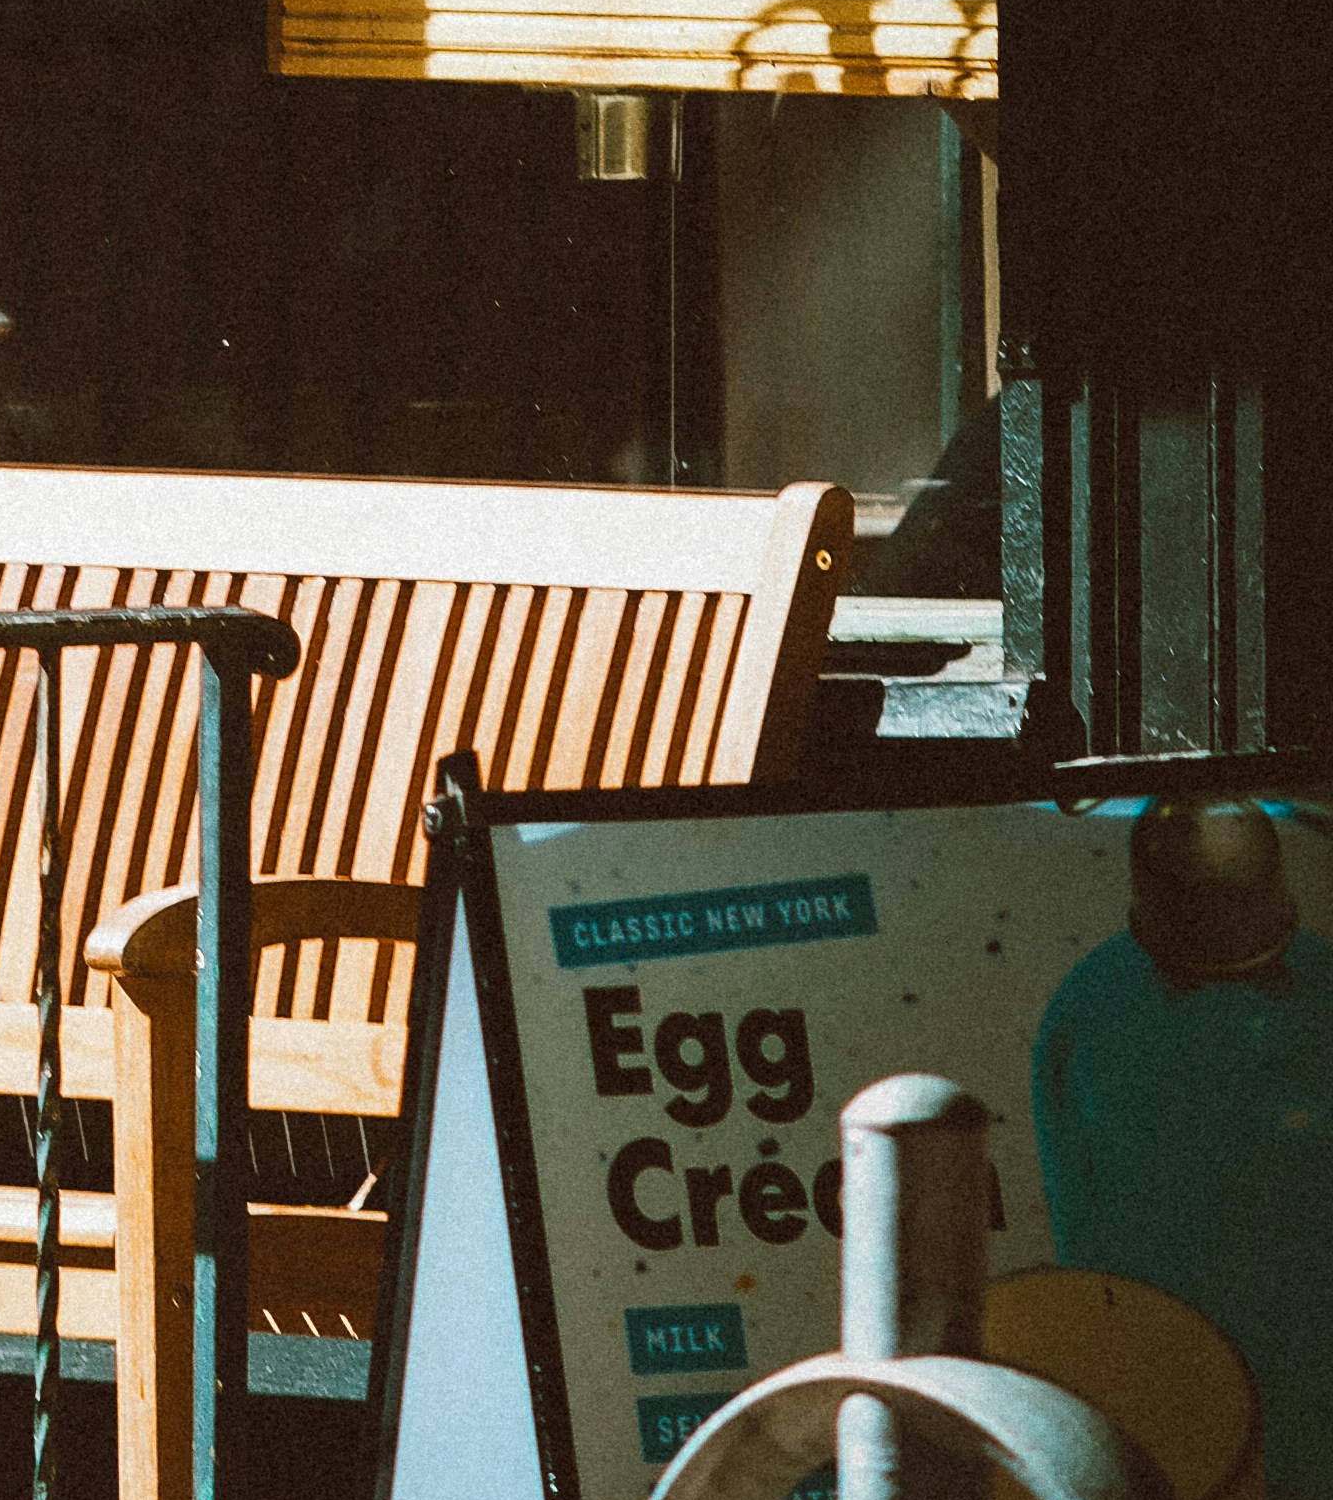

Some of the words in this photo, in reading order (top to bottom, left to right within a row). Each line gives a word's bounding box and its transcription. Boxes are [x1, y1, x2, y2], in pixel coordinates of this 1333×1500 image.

[572, 911, 695, 949] CLASSIC
[704, 903, 766, 935] NEW
[775, 893, 852, 927] YORK
[583, 985, 815, 1129] Egg
[606, 1137, 1008, 1253] Cre
[644, 1322, 727, 1355] MILK
